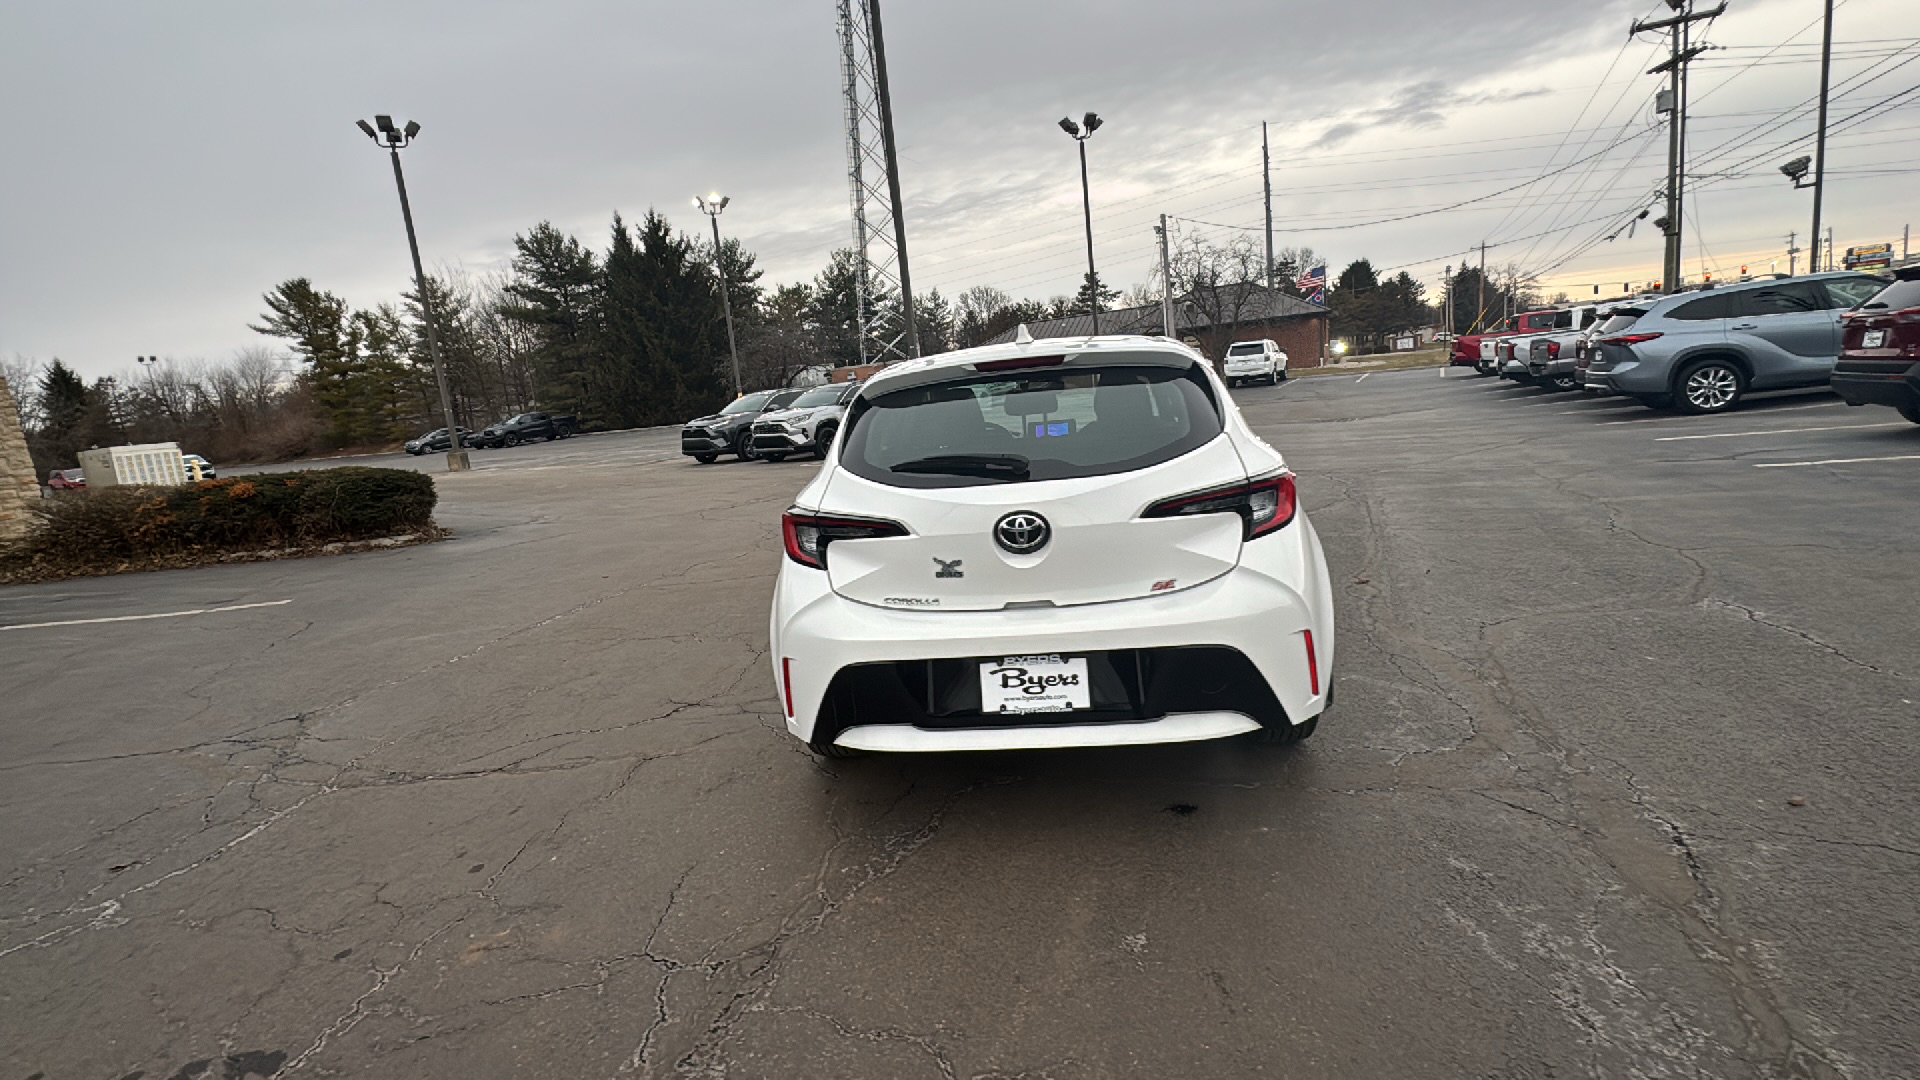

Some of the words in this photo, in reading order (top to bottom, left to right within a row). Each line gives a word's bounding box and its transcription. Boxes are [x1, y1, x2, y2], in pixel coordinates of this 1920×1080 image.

[884, 597, 940, 606] COROLLA
[1003, 654, 1060, 665] BYERS
[989, 668, 1079, 694] Byers
